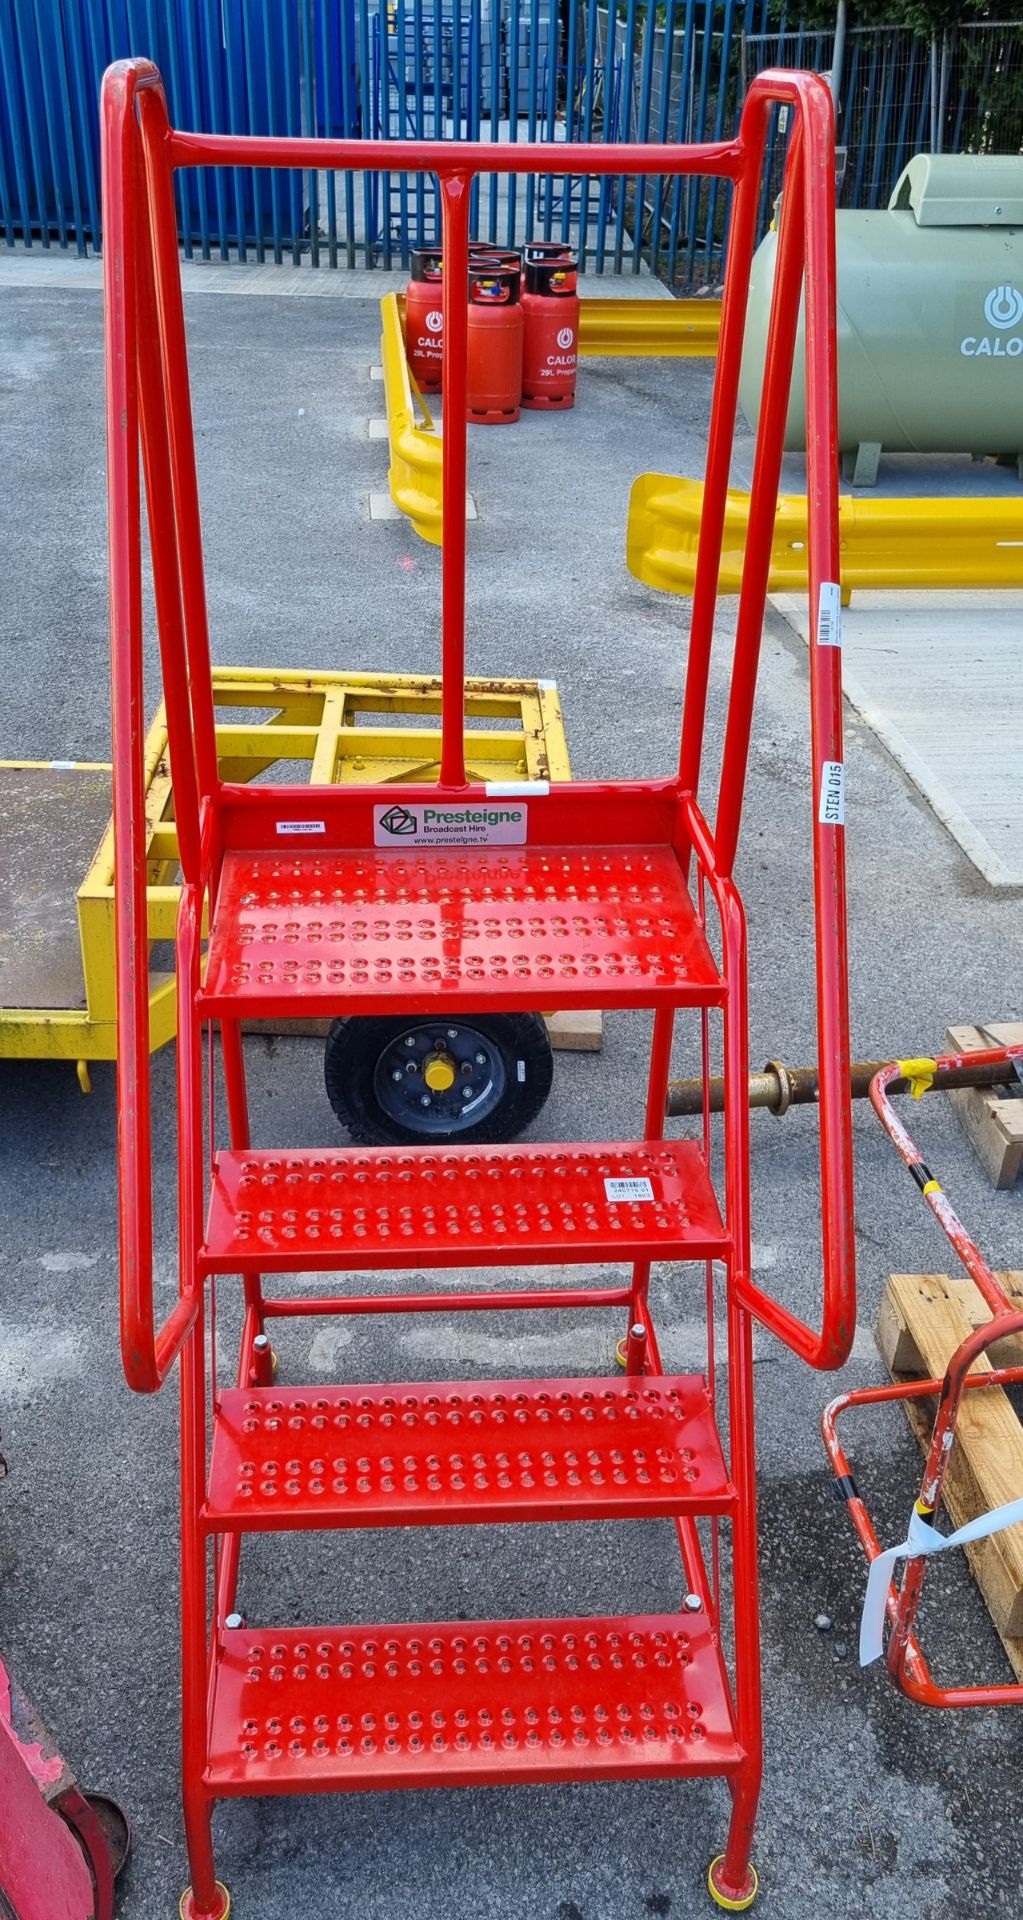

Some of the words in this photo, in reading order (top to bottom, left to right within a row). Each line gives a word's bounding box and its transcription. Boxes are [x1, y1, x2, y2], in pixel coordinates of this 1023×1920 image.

[417, 337, 443, 348] CALO
[960, 336, 1023, 357] CALO
[828, 764, 842, 786] 015
[825, 789, 841, 821] STEN
[423, 808, 522, 826] Presteigne
[423, 825, 467, 833] Broadcast
[413, 836, 488, 845] www.presteigne.tv
